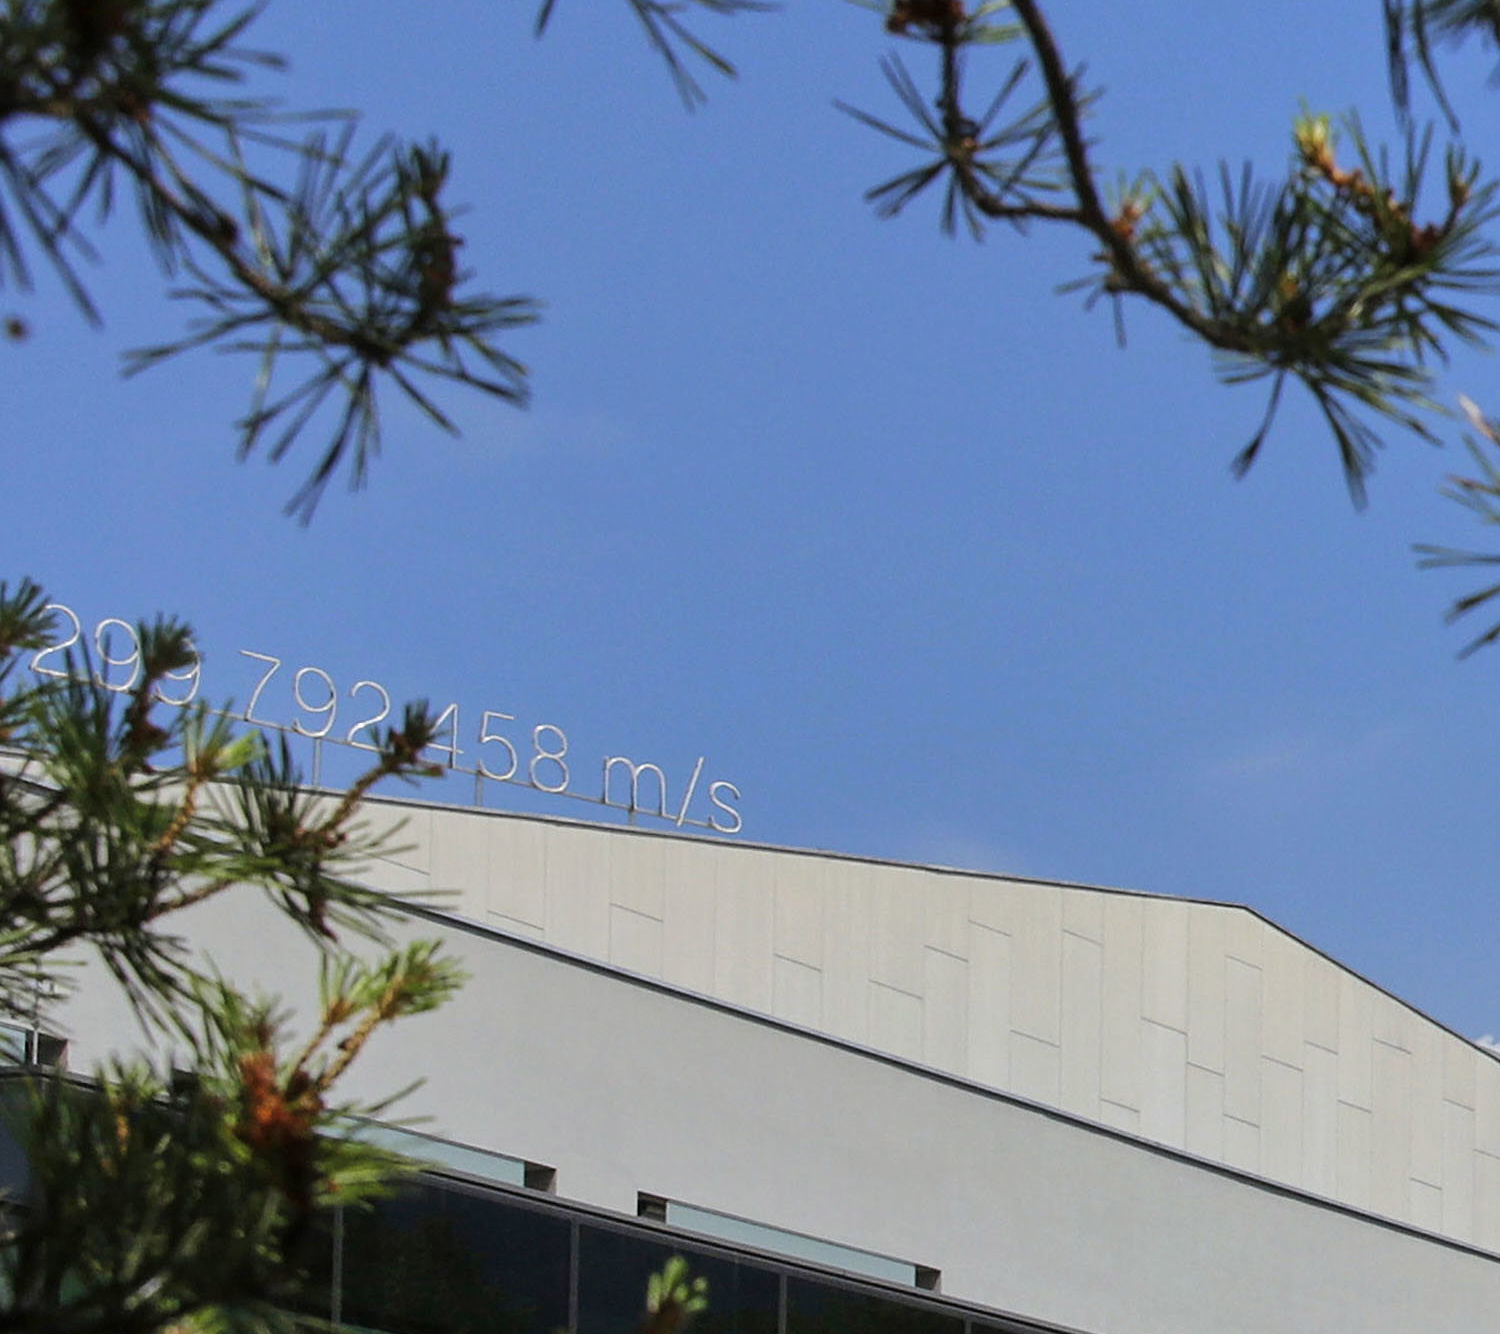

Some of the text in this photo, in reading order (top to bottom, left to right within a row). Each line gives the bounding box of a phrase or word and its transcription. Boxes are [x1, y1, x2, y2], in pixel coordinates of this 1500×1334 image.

[239, 650, 391, 753] 792
[426, 703, 570, 793] 458
[602, 756, 742, 833] m/s
